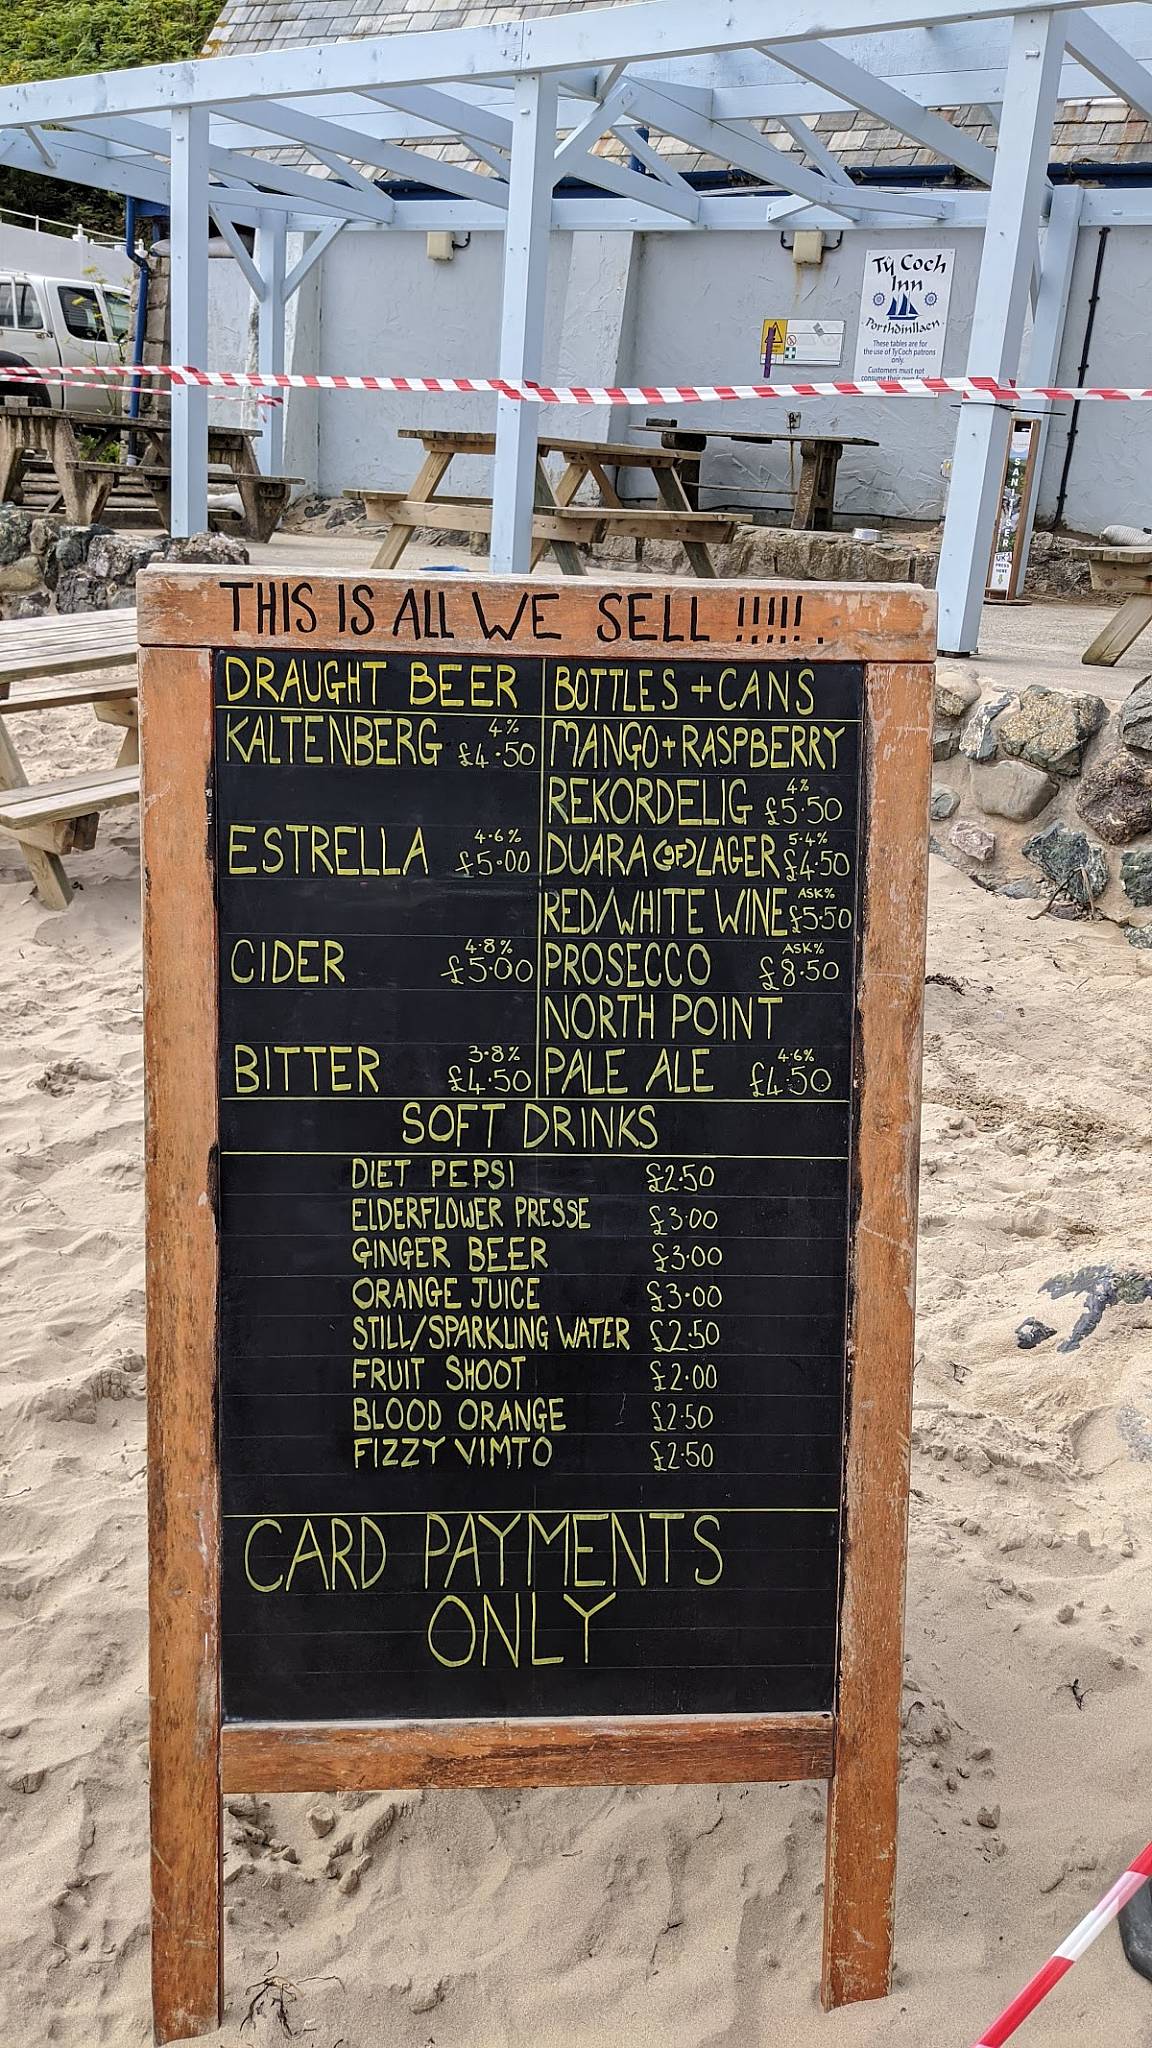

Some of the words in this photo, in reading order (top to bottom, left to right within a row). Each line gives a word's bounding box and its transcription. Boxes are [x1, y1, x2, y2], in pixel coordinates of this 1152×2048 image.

[892, 275, 922, 291] Inn
[901, 254, 946, 274] Coch
[865, 317, 940, 335] Porthdinllaen
[873, 339, 889, 348] These
[890, 339, 907, 348] tables
[919, 339, 928, 348] for
[863, 347, 873, 356] the
[885, 347, 891, 356] of
[914, 348, 936, 357] patrons
[867, 366, 898, 375] Customers
[899, 367, 914, 375] must
[914, 367, 925, 375] not
[1002, 457, 1021, 548] SANITISER
[219, 581, 317, 636] THIS
[338, 583, 375, 636] IS
[392, 588, 455, 641] ALL
[472, 591, 562, 641] WE
[597, 592, 710, 643] SELL
[224, 656, 388, 705] DRAUGHT
[409, 661, 518, 709] BEER
[555, 665, 679, 712] BOTTLES
[225, 713, 443, 766] KALTENBERG
[488, 717, 520, 737] 4%
[548, 776, 753, 826] REKORDELIG
[786, 778, 810, 793] 4%
[228, 824, 429, 876] ESTRELLA
[544, 886, 706, 935] RED/WHITE
[714, 887, 788, 936] WINE
[230, 939, 346, 984] CIDER
[545, 942, 711, 988] PROSECCO
[545, 993, 654, 1040] NORTH
[671, 993, 784, 1041] POINT
[234, 1044, 380, 1094] BITTER
[545, 1046, 629, 1096] PALE
[645, 1047, 714, 1094] ALE
[401, 1101, 506, 1149] SOFT
[523, 1102, 659, 1150] DRINKS
[351, 1157, 412, 1190] DIET
[431, 1158, 515, 1190] PEPSI
[351, 1196, 504, 1232] ELDERFLOWER
[515, 1196, 592, 1230] PRESSE
[351, 1236, 451, 1270] GINGER
[468, 1235, 549, 1272] BEER
[352, 1276, 462, 1310] ORANGE
[470, 1277, 541, 1310] JUICE
[352, 1314, 548, 1352] STILL/SPARKLING
[556, 1316, 630, 1351] WATER
[352, 1356, 425, 1392] FRUIT
[446, 1355, 526, 1391] SHOOT
[353, 1397, 442, 1432] BLOOD
[458, 1397, 567, 1433] ORANGE
[353, 1436, 446, 1469] FIZZY
[454, 1435, 553, 1469] VIMTO
[244, 1516, 387, 1593] CARD
[425, 1511, 723, 1589] PAYMENTS
[427, 1591, 616, 1668] ONLY
